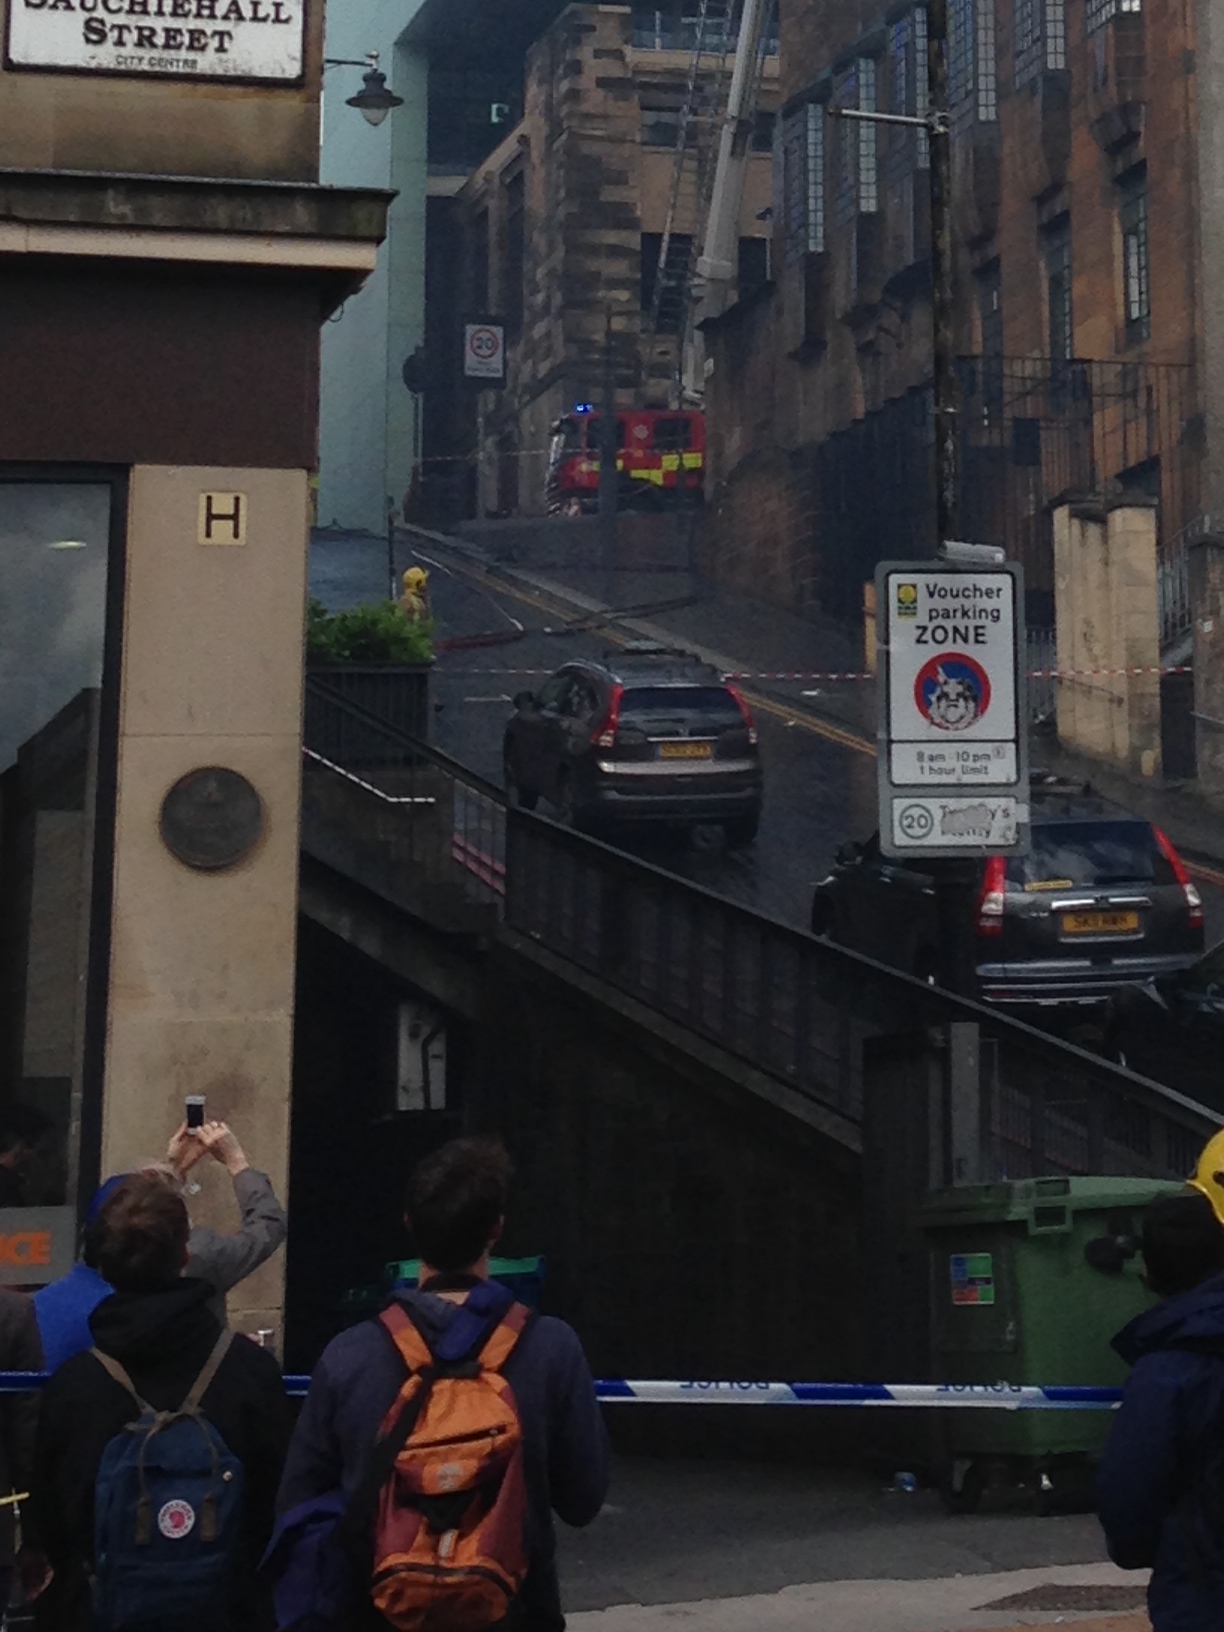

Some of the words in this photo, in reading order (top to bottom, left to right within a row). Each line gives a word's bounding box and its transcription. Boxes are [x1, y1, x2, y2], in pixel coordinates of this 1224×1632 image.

[83, 17, 233, 53] STREET
[116, 54, 144, 66] CITY
[150, 56, 198, 69] CENTRE
[205, 495, 240, 539] H
[926, 583, 1003, 599] Voucher
[928, 604, 1001, 623] parking
[915, 625, 988, 645] ZONE
[956, 751, 970, 762] 10
[972, 754, 991, 765] pm
[929, 765, 956, 775] hour
[961, 765, 990, 775] limit
[904, 814, 929, 830] 20
